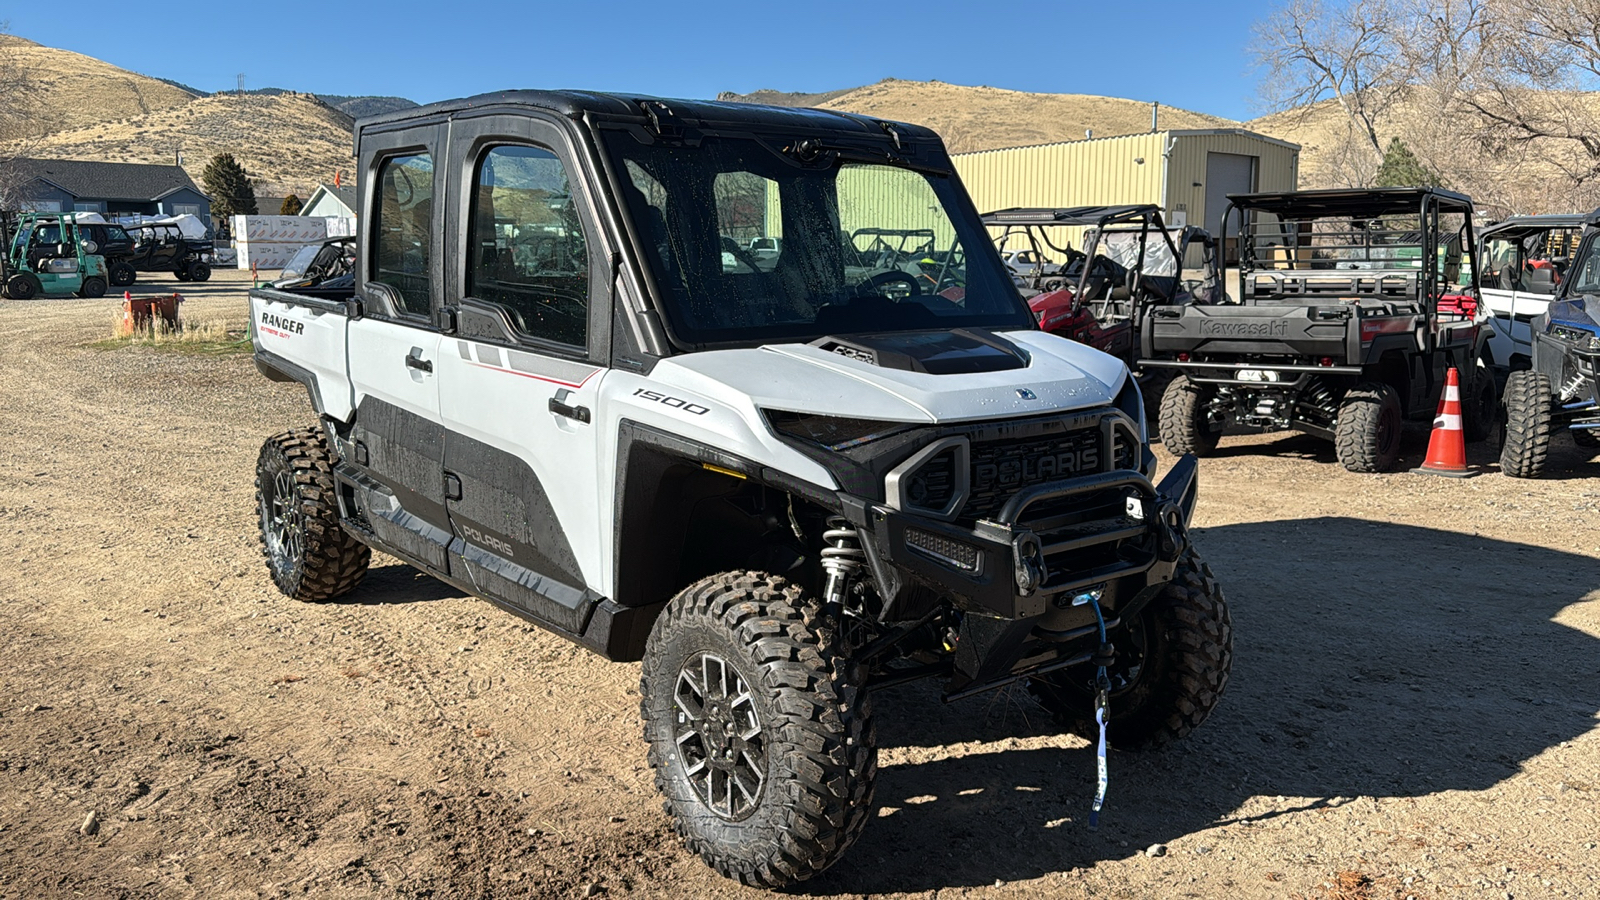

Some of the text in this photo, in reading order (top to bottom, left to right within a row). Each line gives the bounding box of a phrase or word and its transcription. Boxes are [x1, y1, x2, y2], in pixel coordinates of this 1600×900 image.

[261, 312, 304, 335] RANGER
[1199, 319, 1289, 336] Kawasaki
[633, 388, 711, 415] 1500
[976, 447, 1099, 485] POLARIS
[463, 525, 514, 557] POLARIS
[1092, 755, 1107, 812] POLARIS
